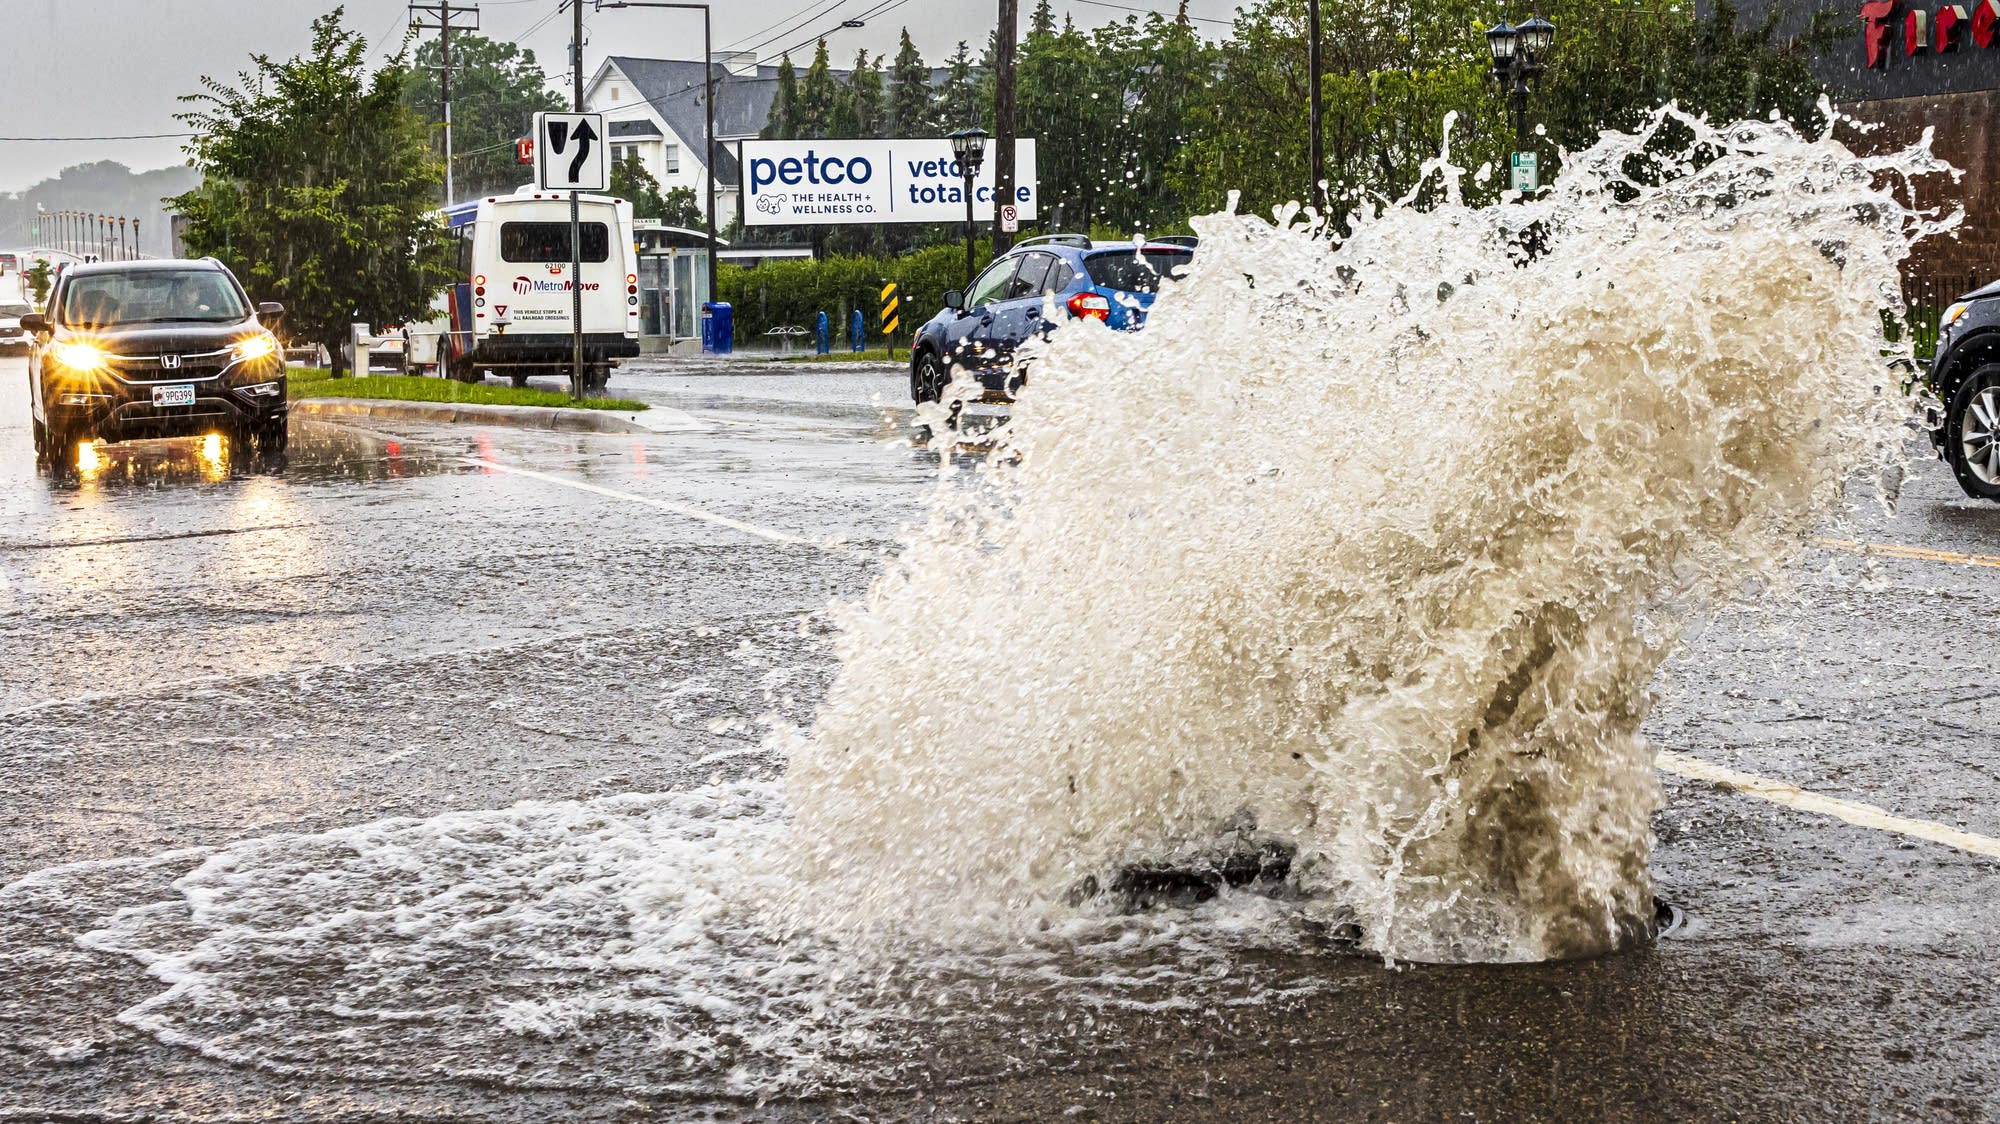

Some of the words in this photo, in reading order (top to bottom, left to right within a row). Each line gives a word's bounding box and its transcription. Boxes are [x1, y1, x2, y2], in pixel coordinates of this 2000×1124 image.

[750, 150, 872, 195] petco
[792, 193, 814, 202] THE
[818, 193, 862, 202] HEALTH
[909, 183, 968, 203] total
[976, 186, 1031, 202] ce
[792, 205, 853, 214] WELLNESS
[856, 204, 877, 213] CO.
